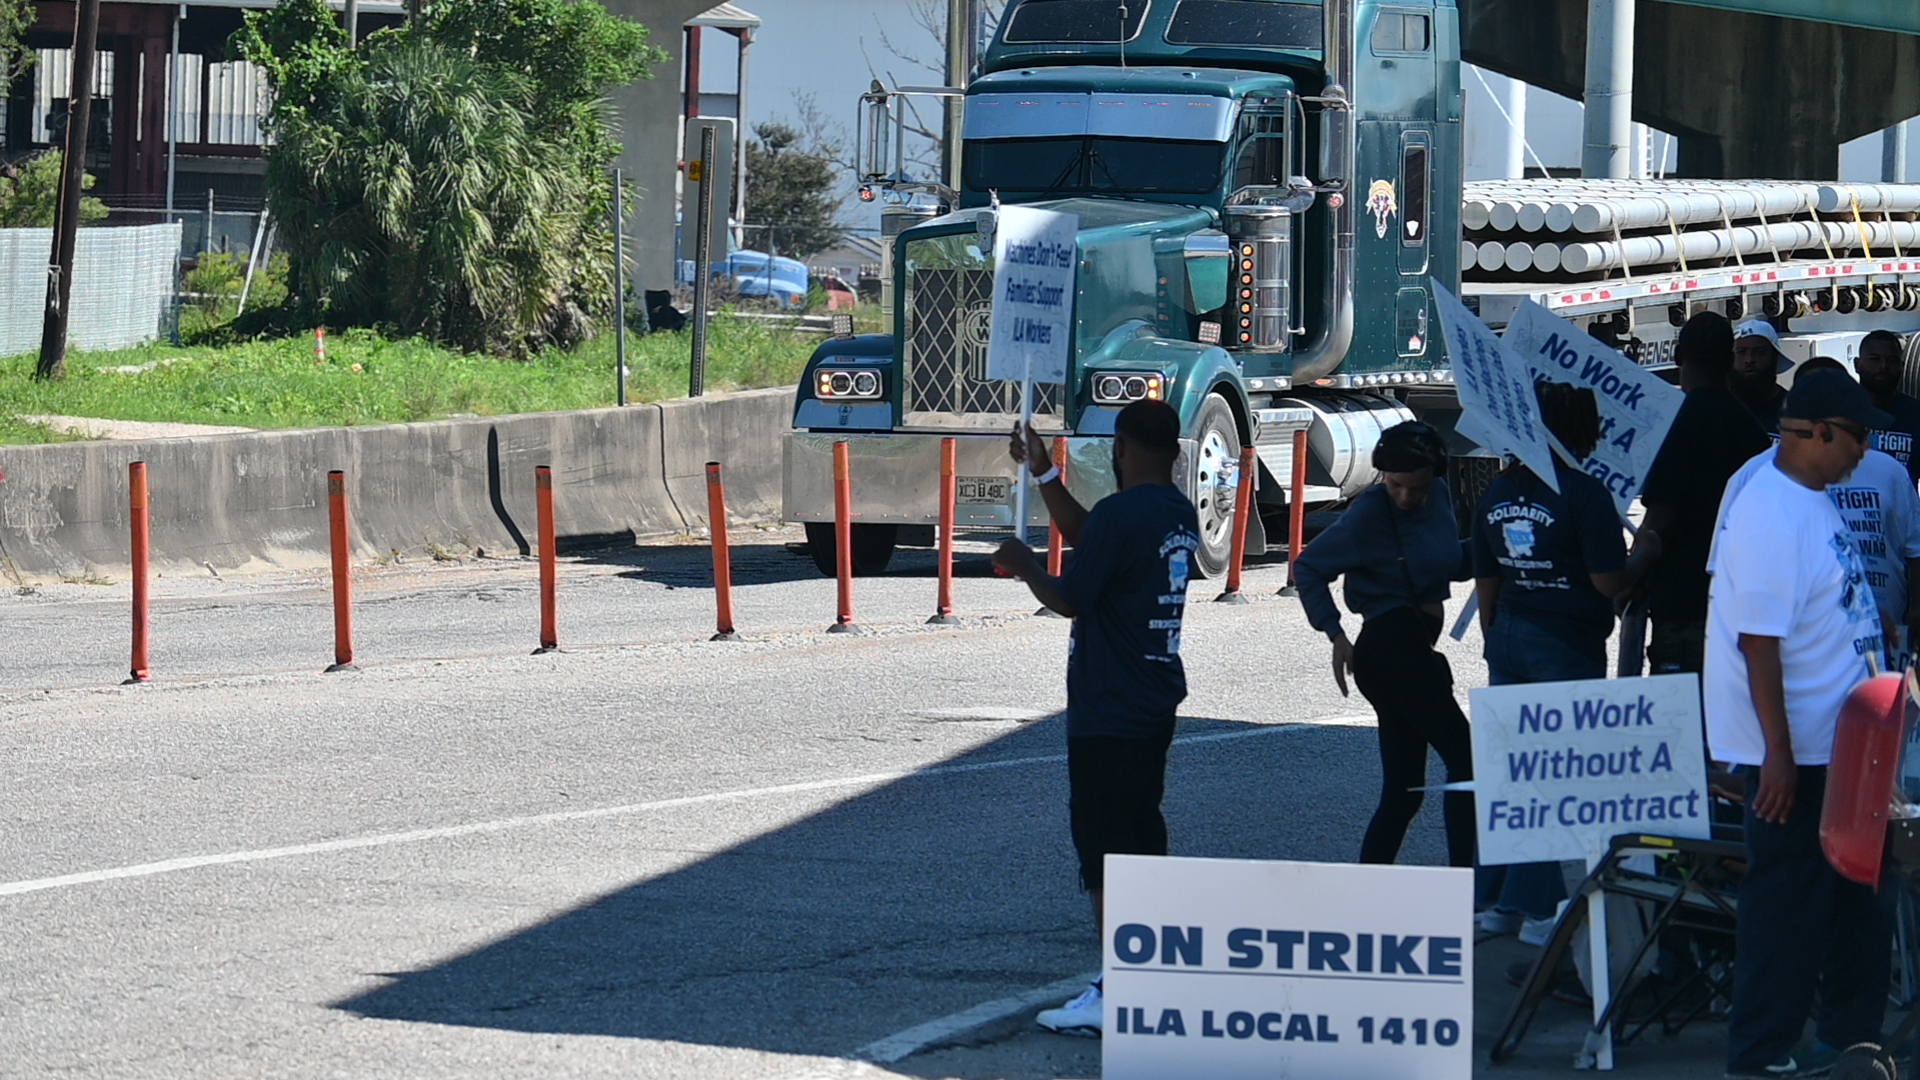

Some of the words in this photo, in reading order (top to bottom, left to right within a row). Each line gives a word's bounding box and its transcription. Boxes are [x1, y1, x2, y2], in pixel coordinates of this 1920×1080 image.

[1056, 244, 1073, 268] Feed
[1006, 277, 1036, 303] Families
[1037, 281, 1064, 310] Support
[1013, 317, 1026, 342] ILA
[1026, 318, 1052, 344] Workers
[1637, 340, 1680, 365] BENSO
[1539, 333, 1578, 369] No
[1580, 355, 1645, 411] Work
[1612, 427, 1637, 454] A
[1878, 434, 1913, 452] FIGHT
[1837, 491, 1881, 510] FIGHT
[1487, 506, 1555, 527] SOLIDARITY
[1863, 511, 1881, 520] THEY
[1858, 540, 1887, 559] WAR
[1519, 703, 1563, 734] No
[1573, 695, 1655, 731] Work
[1508, 745, 1642, 782] Without
[1650, 742, 1673, 773] A
[1488, 798, 1551, 831] Fair
[1557, 789, 1700, 827] Contract
[1114, 923, 1203, 966] ON
[1227, 928, 1462, 976] STRIKE
[1116, 1006, 1187, 1037] ILA
[1202, 1010, 1339, 1043] LOCAL
[1357, 1016, 1460, 1047] 1410
